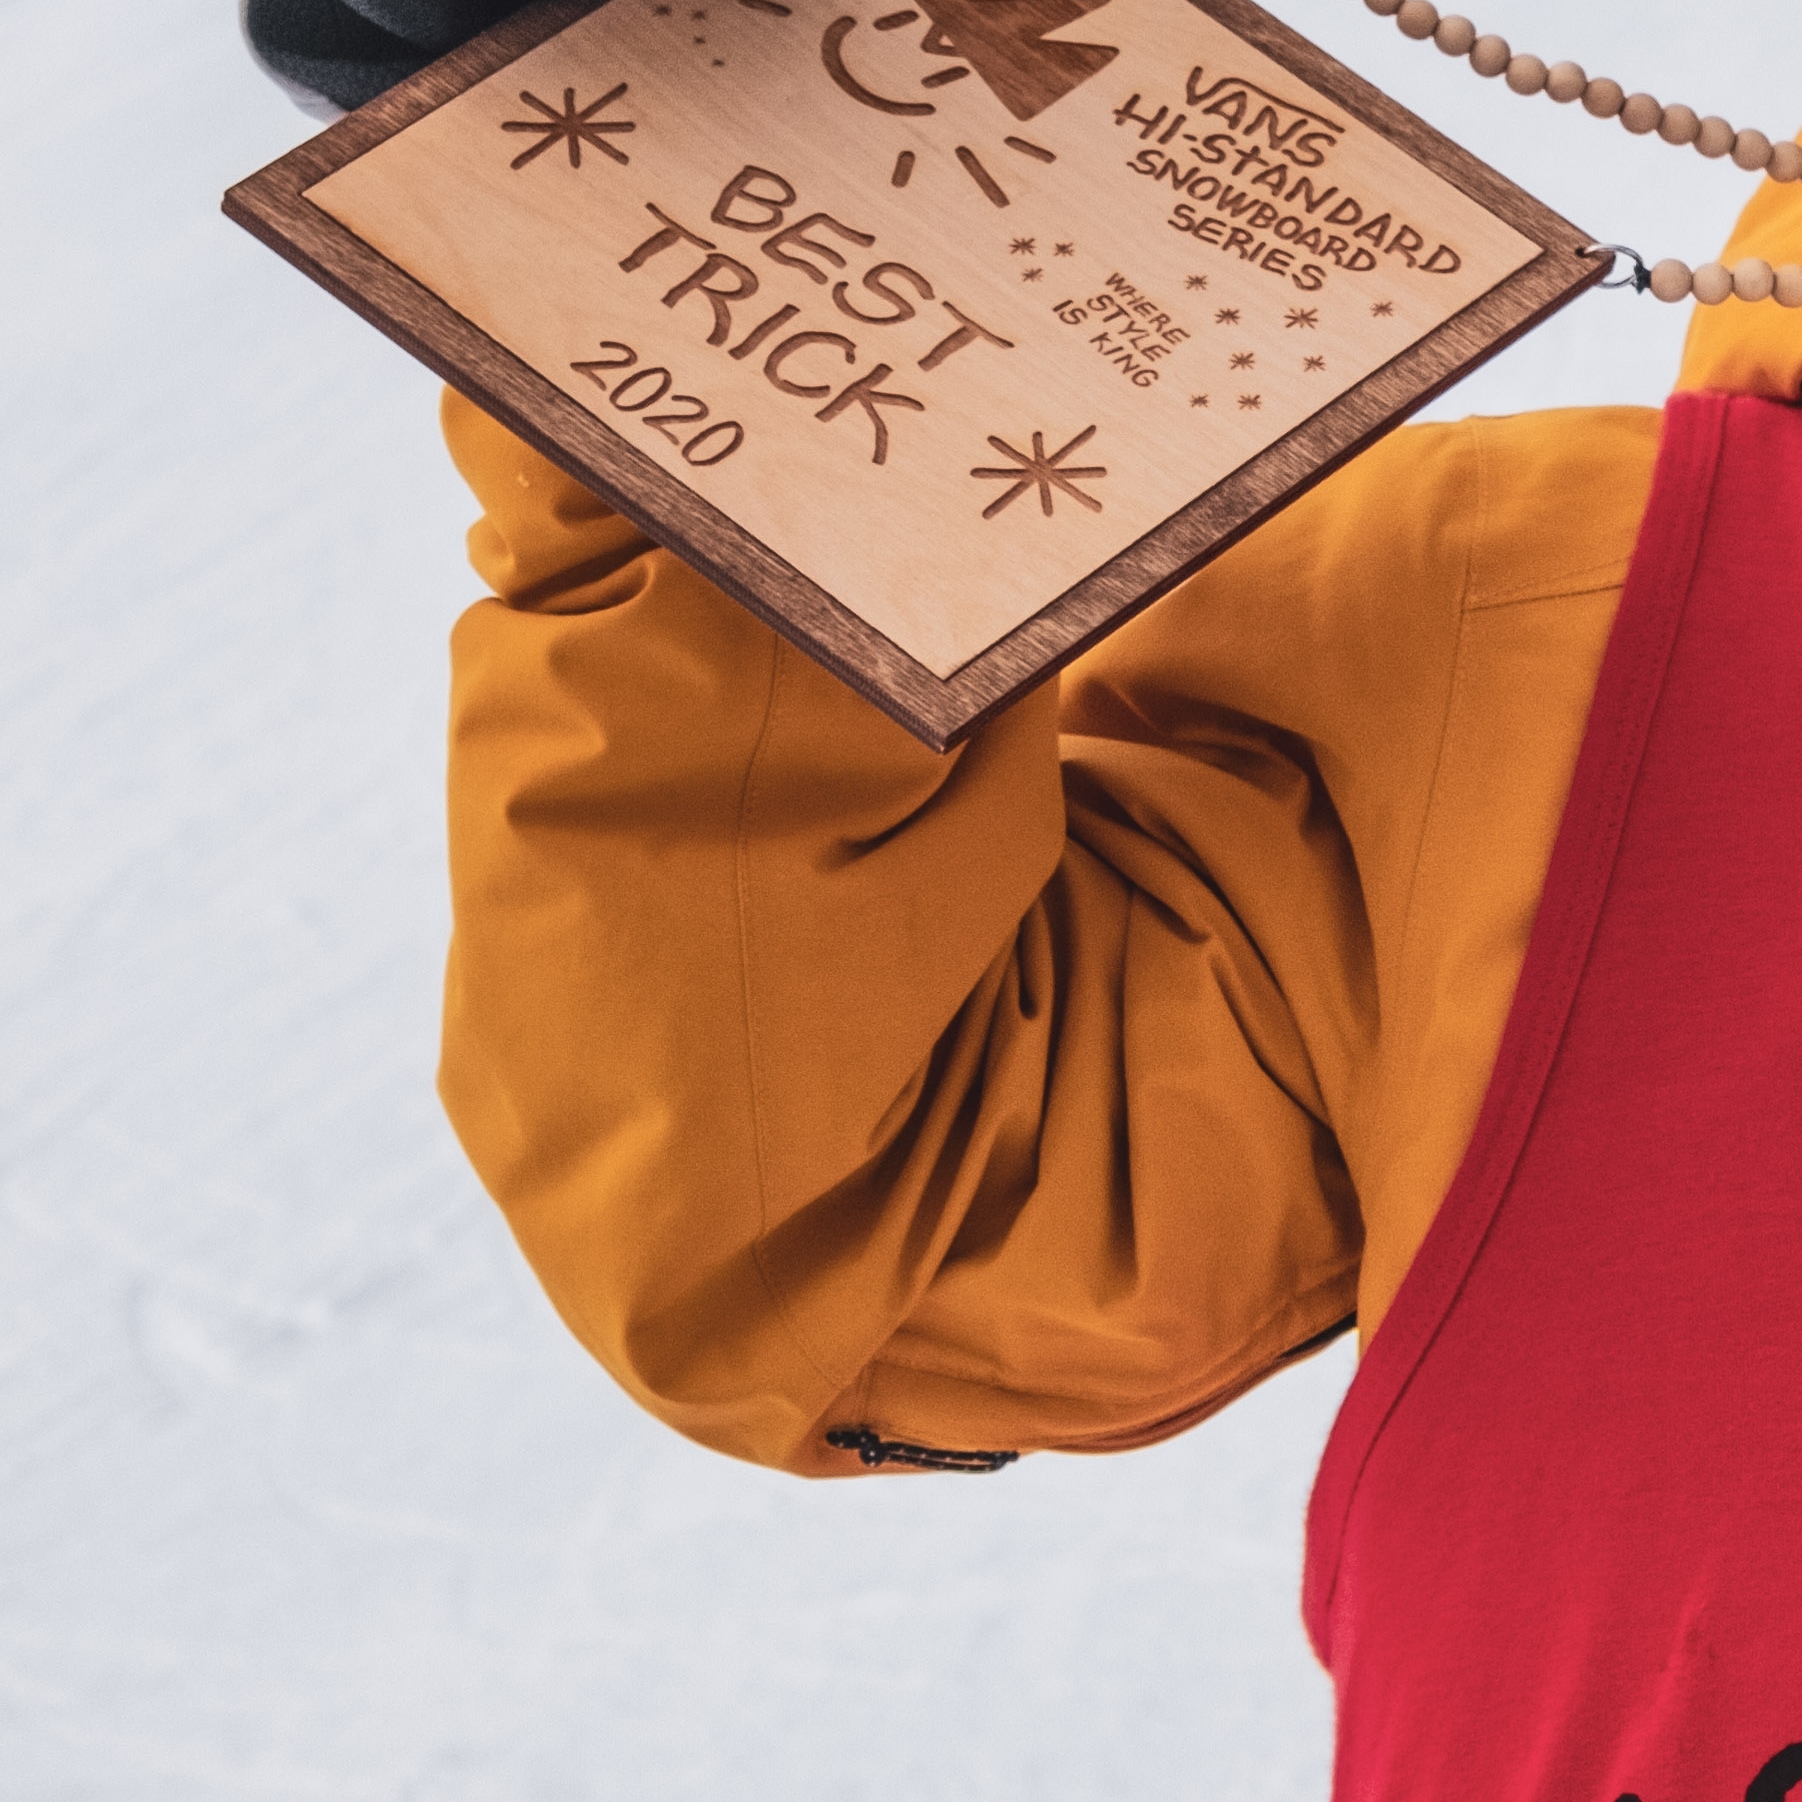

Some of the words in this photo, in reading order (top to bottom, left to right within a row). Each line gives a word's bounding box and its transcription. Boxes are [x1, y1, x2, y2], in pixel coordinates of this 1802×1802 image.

[1185, 65, 1346, 168] VANS
[1112, 93, 1463, 275] HI-STANDARD
[1126, 149, 1378, 273] SNOWBOARD
[710, 164, 1016, 373] BEST
[1167, 203, 1327, 292] SERIES
[618, 201, 926, 466] TRICK
[1052, 298, 1089, 326] IS
[1089, 331, 1160, 388] KING
[1086, 294, 1172, 363] STYLE
[1104, 271, 1192, 346] WHERE
[569, 339, 745, 467] 2020
